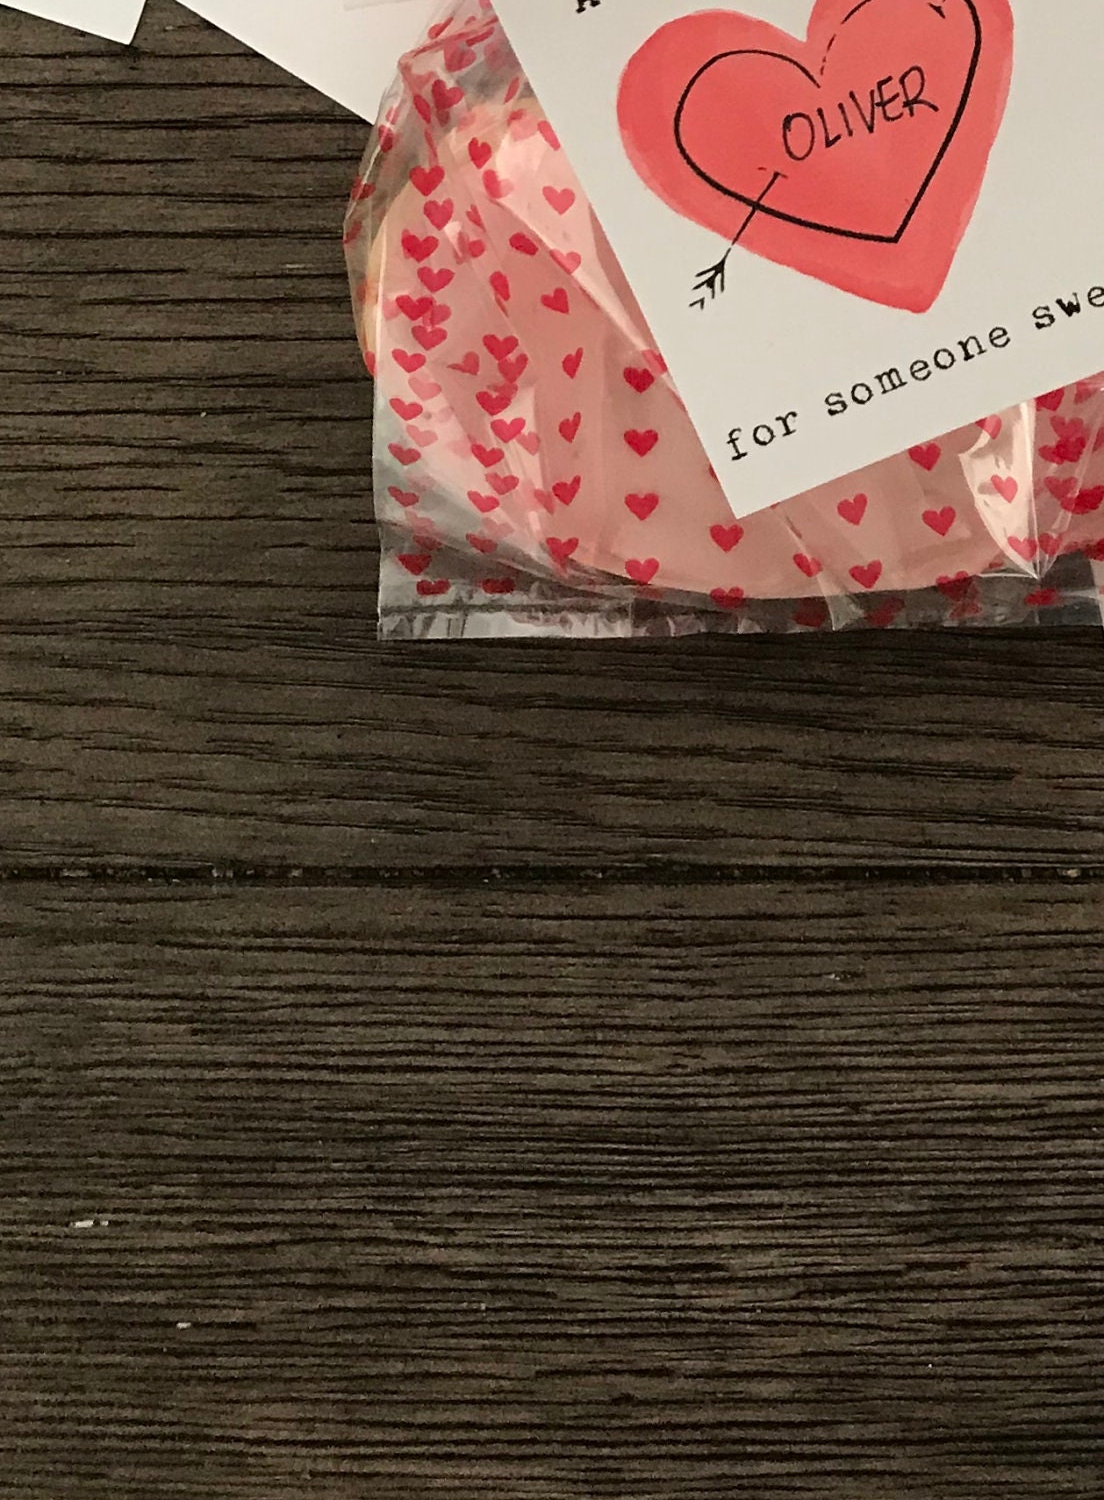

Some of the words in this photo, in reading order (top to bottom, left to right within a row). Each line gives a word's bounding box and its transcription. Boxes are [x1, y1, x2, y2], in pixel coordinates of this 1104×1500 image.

[782, 65, 939, 161] OLIVER
[726, 410, 798, 462] for
[824, 326, 1011, 417] someone
